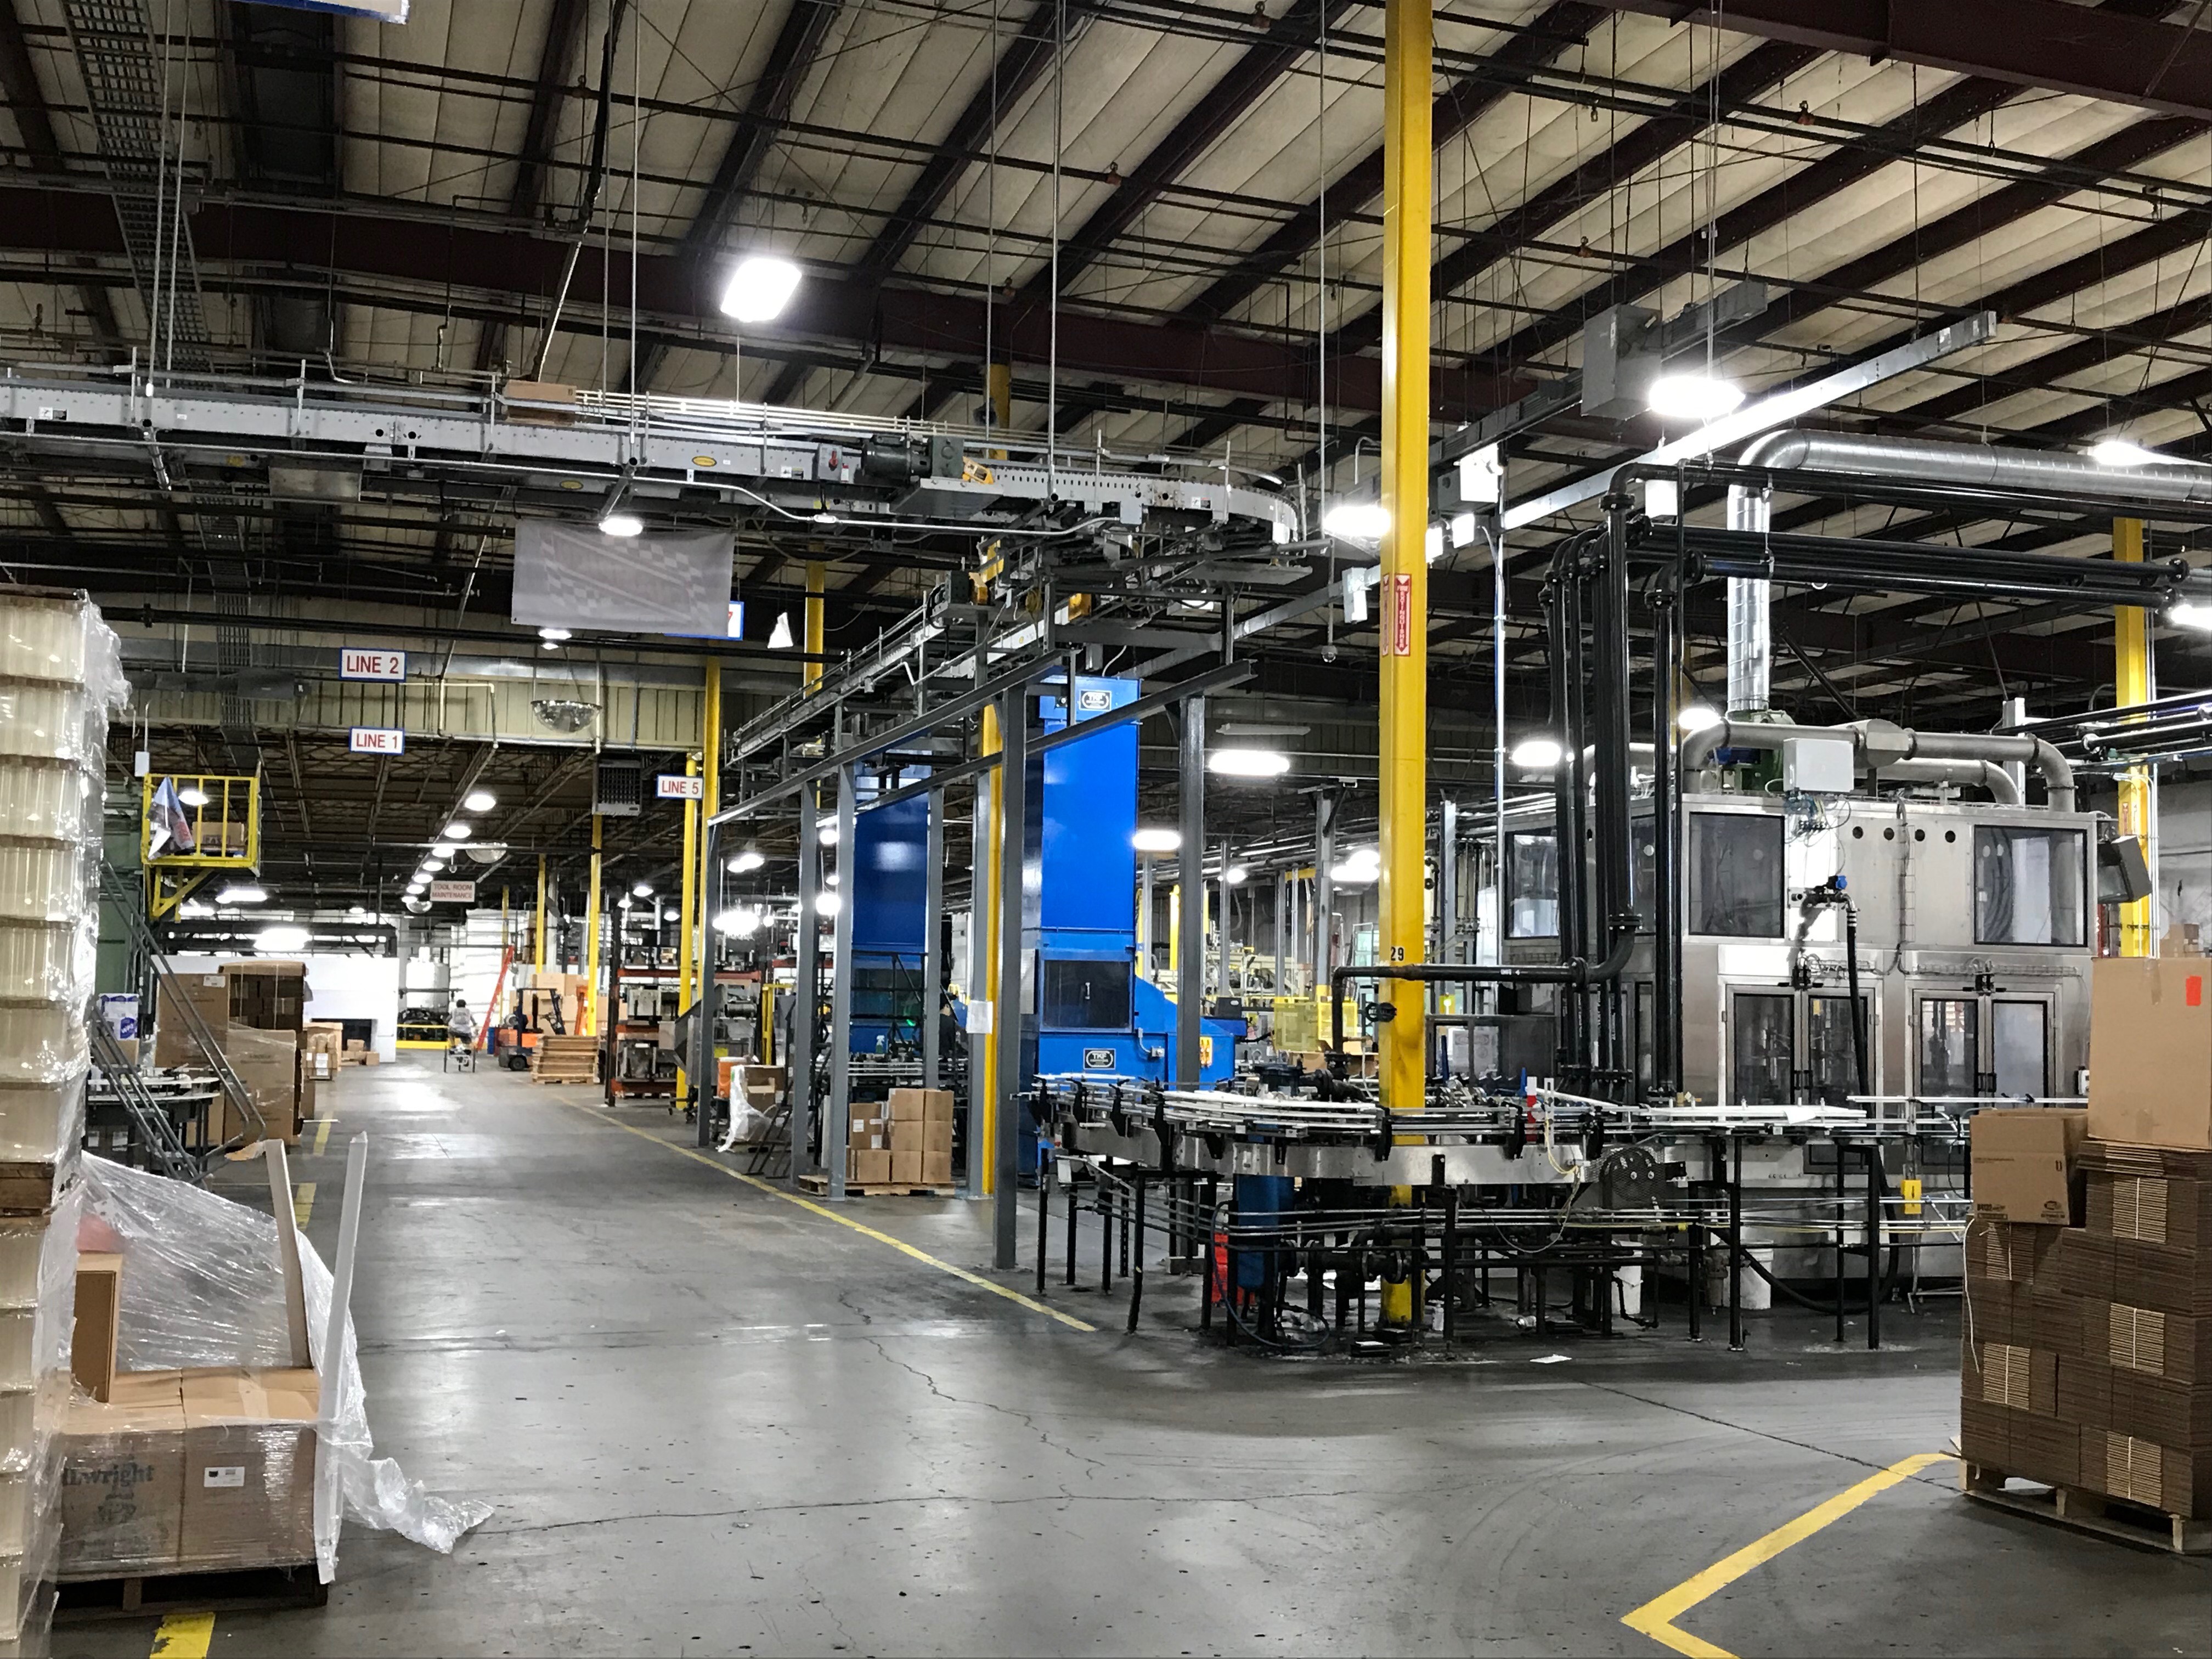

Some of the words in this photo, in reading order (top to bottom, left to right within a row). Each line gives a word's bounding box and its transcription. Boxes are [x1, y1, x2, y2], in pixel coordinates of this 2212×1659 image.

[347, 655, 382, 674] LINE
[389, 657, 399, 674] 2
[356, 733, 386, 748] LINE
[392, 735, 398, 749] 1
[662, 780, 686, 794] LINE
[692, 782, 699, 794] 5
[1391, 946, 1404, 961] 29
